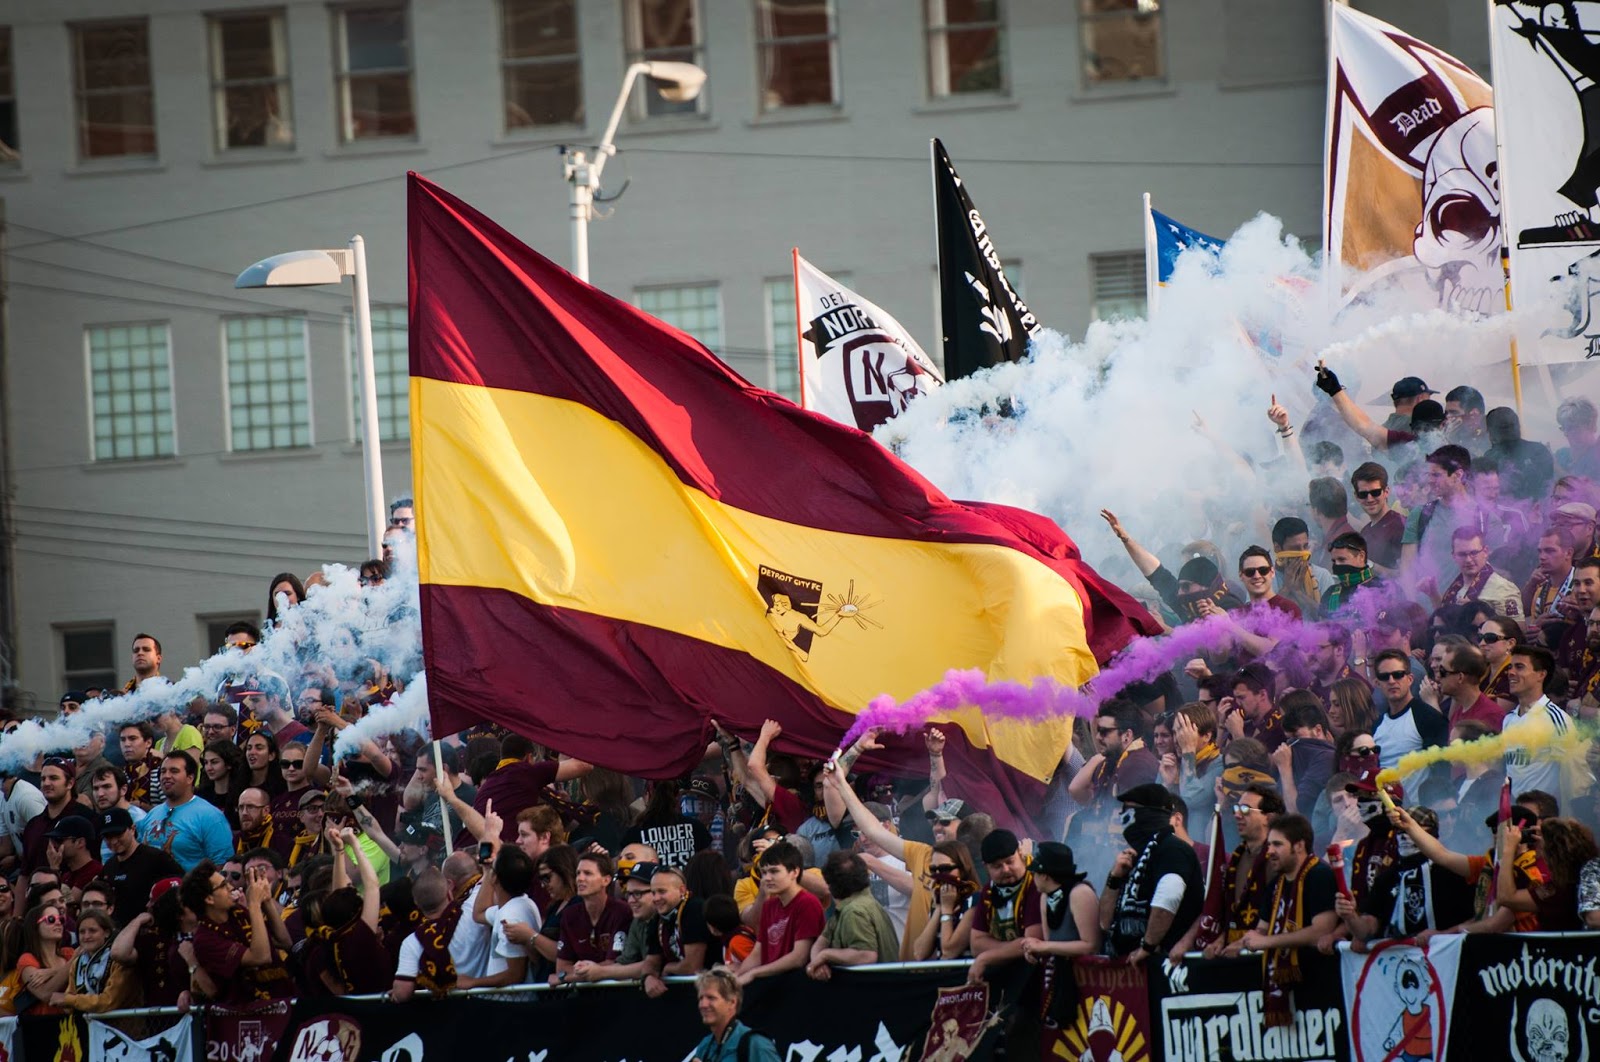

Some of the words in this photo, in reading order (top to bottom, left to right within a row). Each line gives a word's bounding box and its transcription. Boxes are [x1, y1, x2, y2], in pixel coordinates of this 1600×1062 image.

[1389, 98, 1443, 137] Dead
[820, 292, 848, 309] DET
[821, 306, 878, 339] NOR
[762, 568, 792, 581] DETROIT
[794, 579, 810, 588] CITY
[811, 583, 821, 591] FC
[641, 824, 694, 844] LOUDER
[648, 841, 671, 855] AN
[673, 838, 695, 853] OUR
